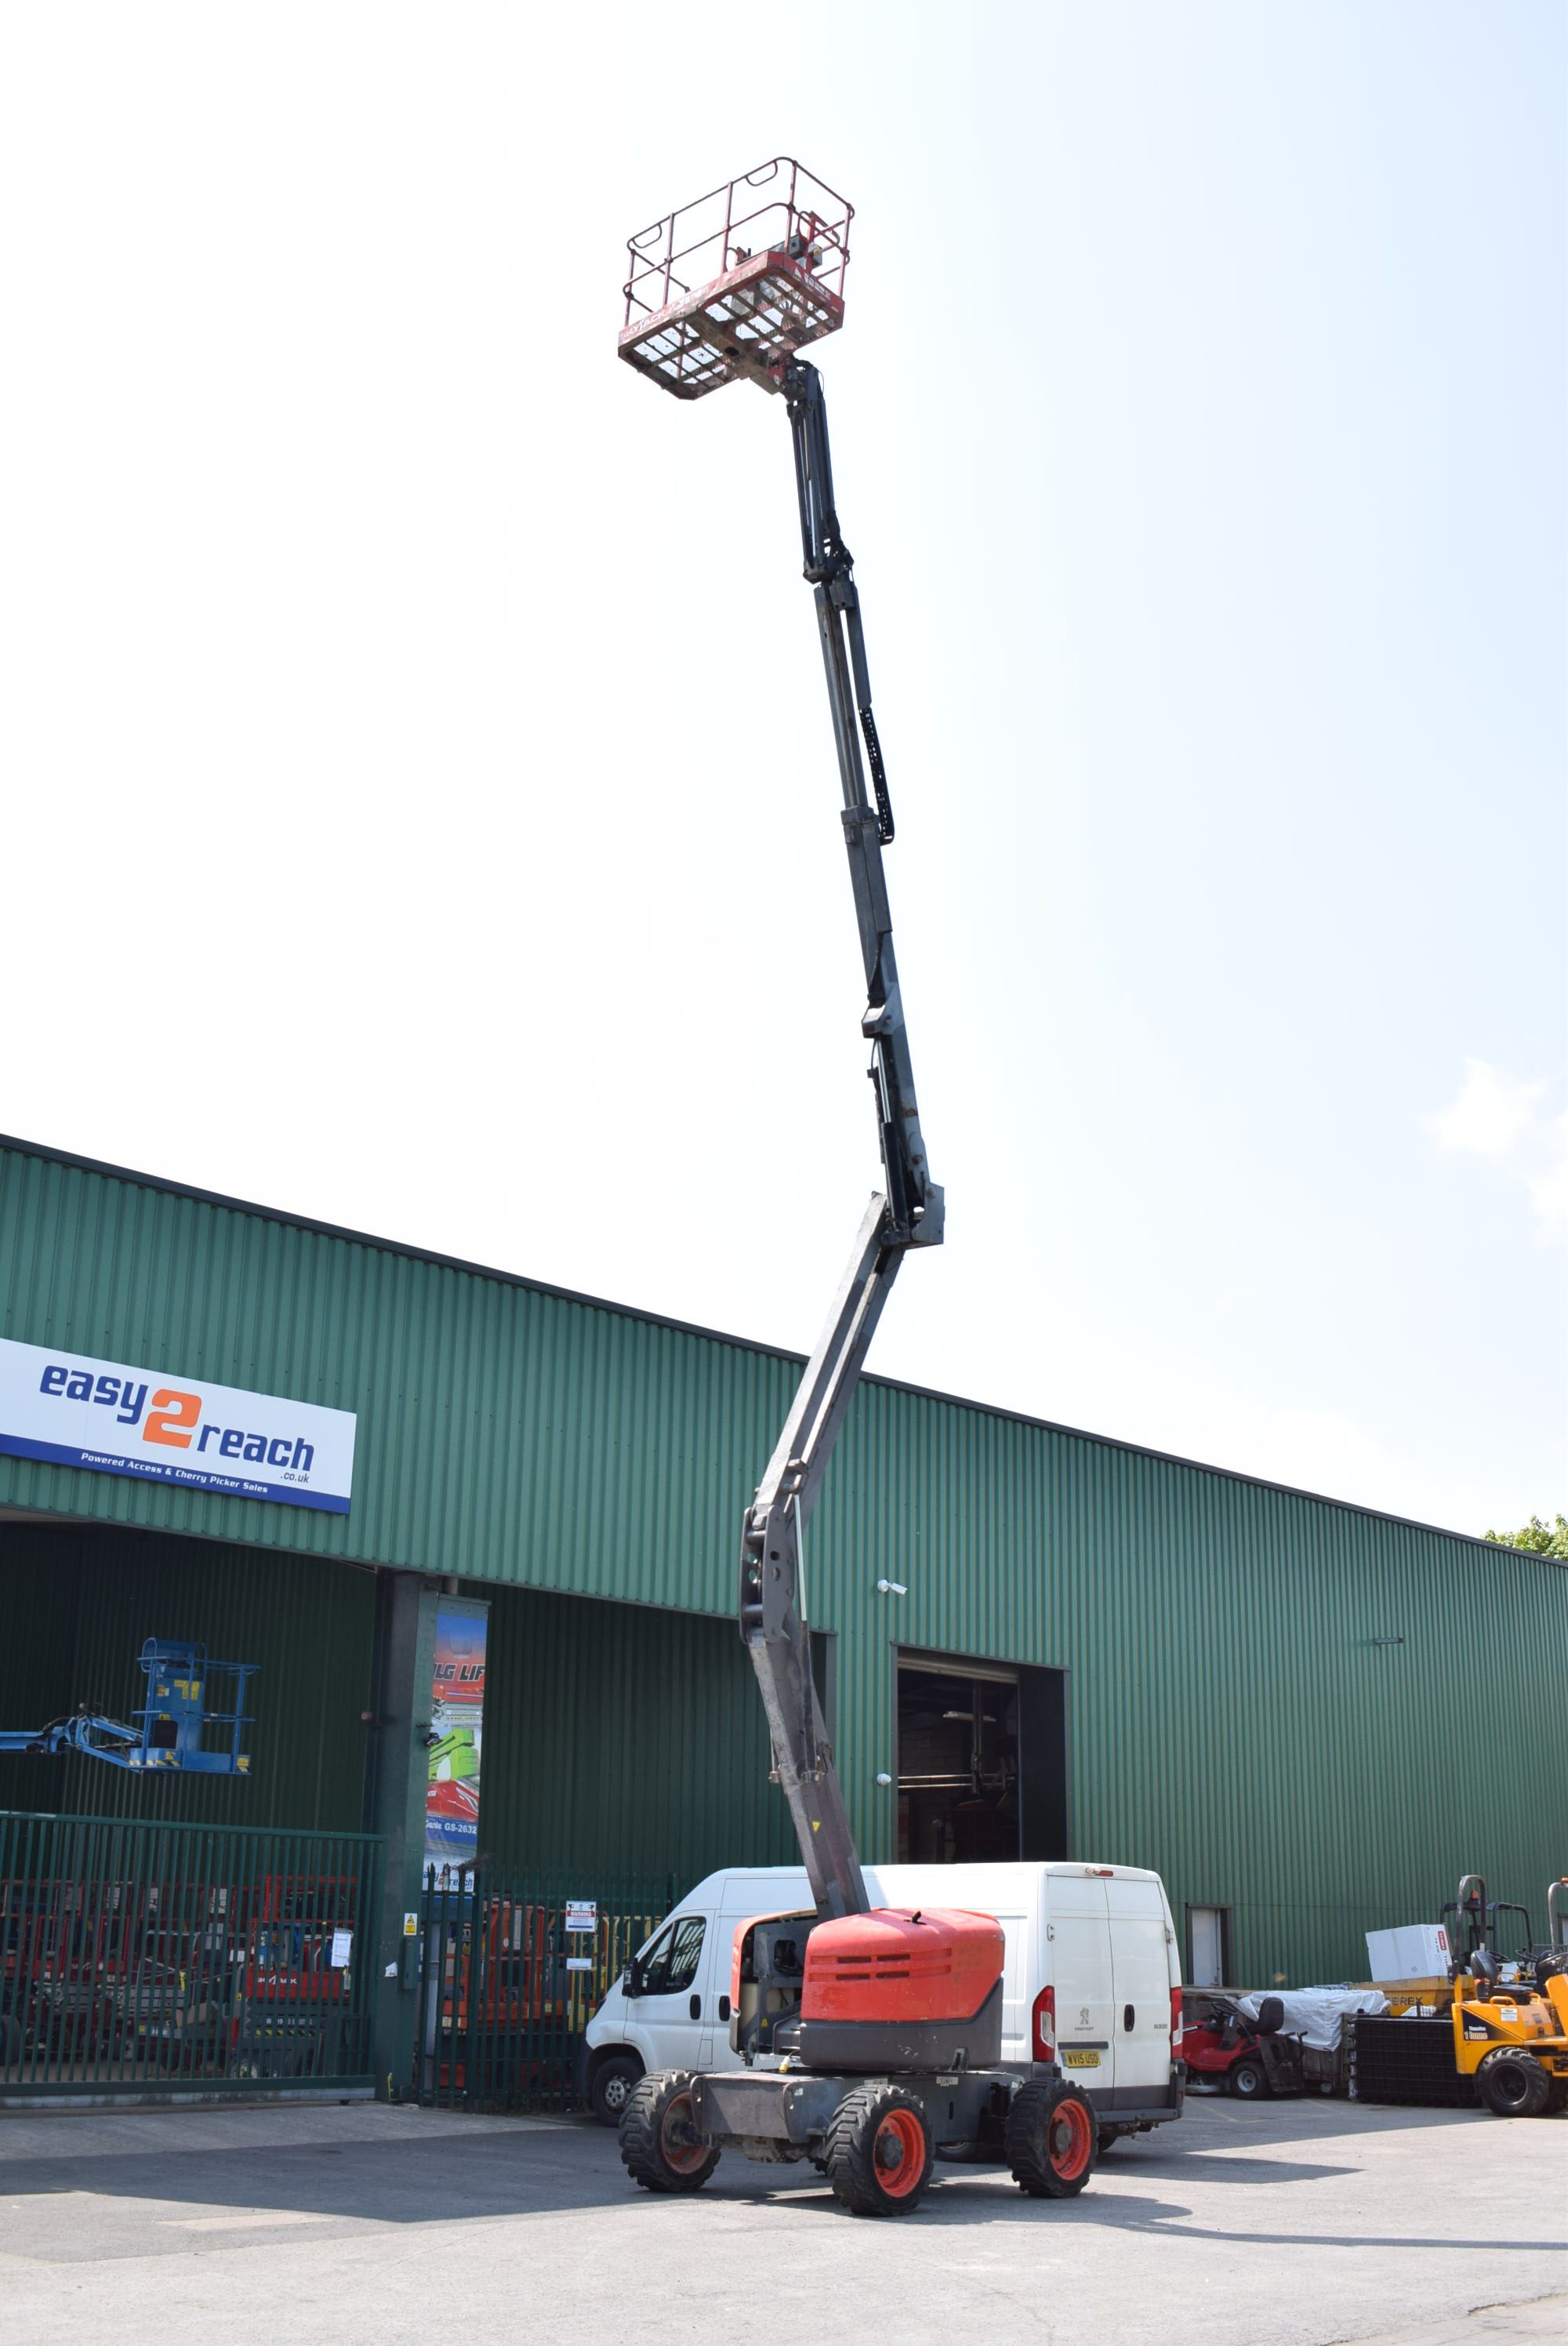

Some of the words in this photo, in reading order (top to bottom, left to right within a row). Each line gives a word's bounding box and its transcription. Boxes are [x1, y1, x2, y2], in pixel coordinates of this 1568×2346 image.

[619, 310, 666, 340] KYJACK
[81, 1452, 125, 1467] Powered
[127, 1461, 162, 1473] Access
[165, 1467, 172, 1476] &
[176, 1469, 207, 1484] Cherry
[209, 1476, 240, 1488] Picker
[242, 1482, 268, 1493] Sales
[280, 1472, 310, 1484] .co.uk
[444, 1822, 477, 1835] GS-2632
[1386, 1996, 1423, 2006] EREX
[1066, 2053, 1084, 2064] WV15
